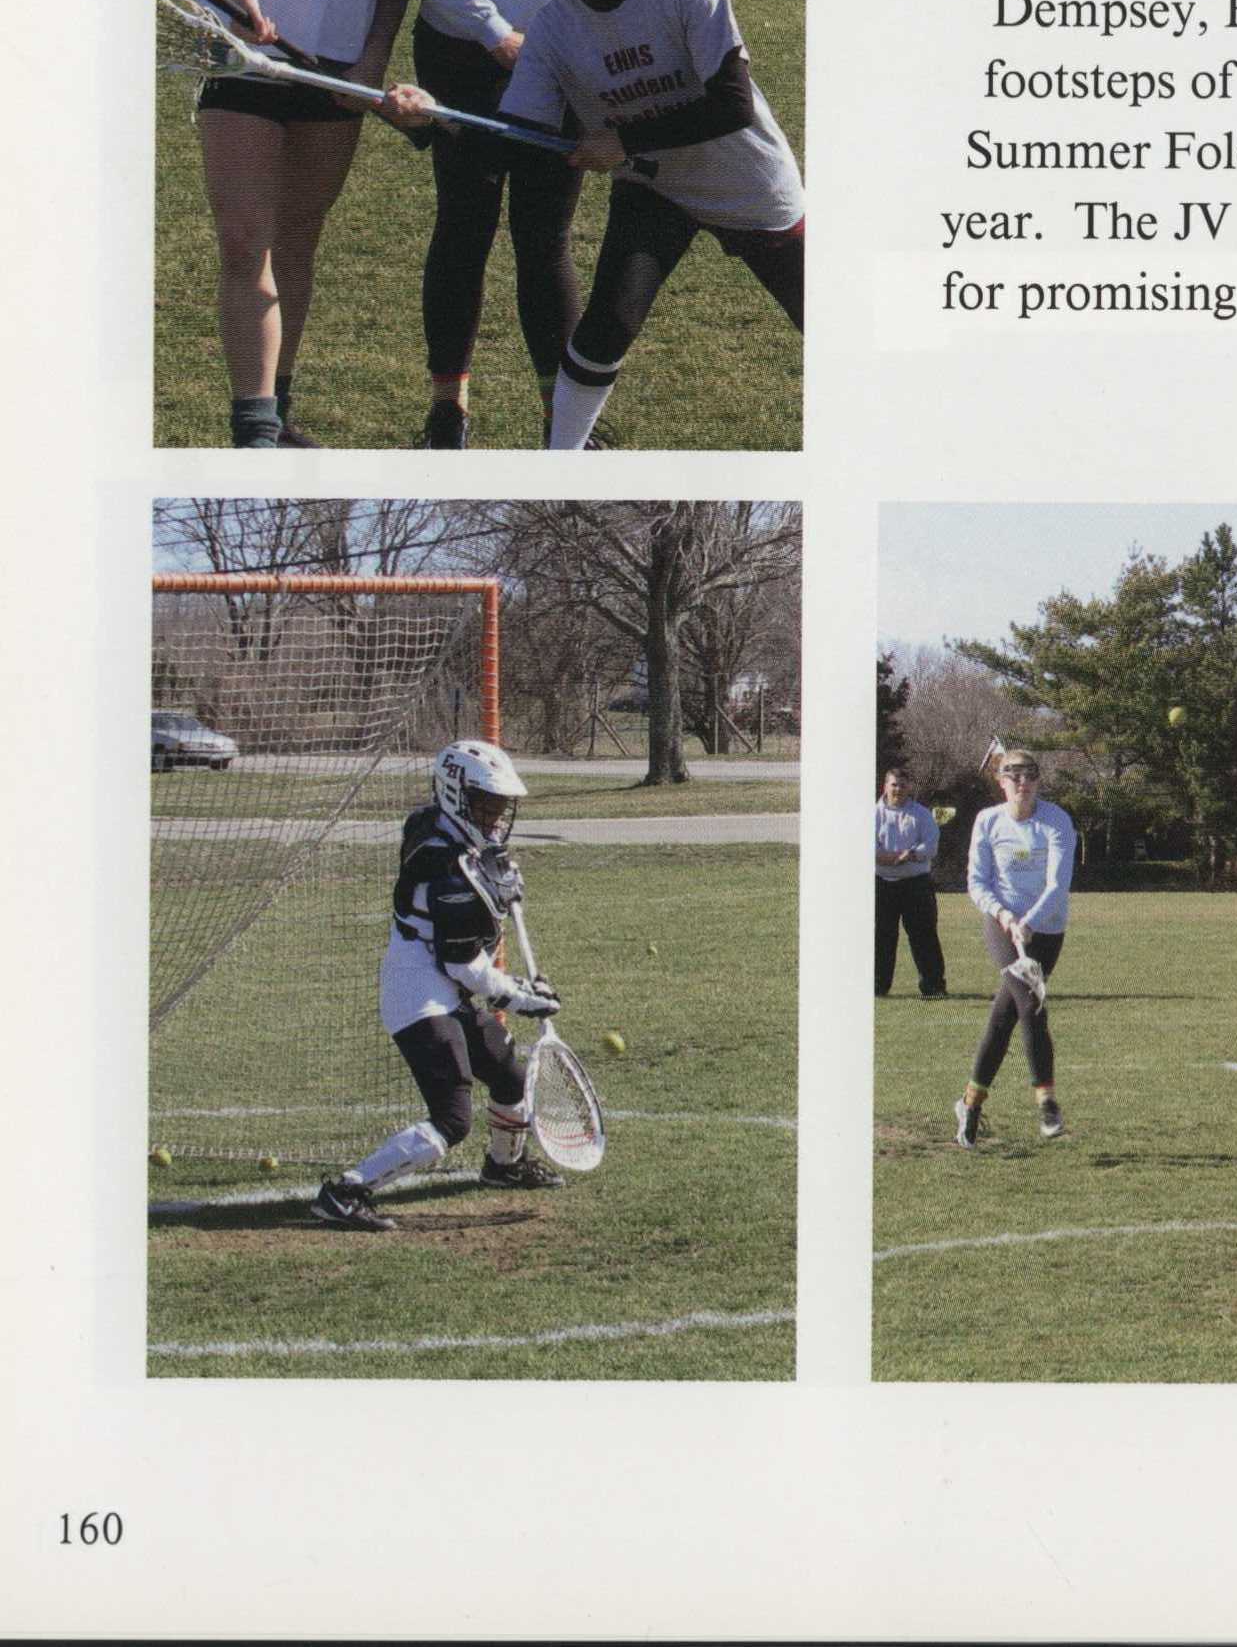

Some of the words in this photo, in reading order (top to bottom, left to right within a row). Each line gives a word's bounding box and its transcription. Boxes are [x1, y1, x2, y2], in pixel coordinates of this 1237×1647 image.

[984, 58, 1176, 108] footsteps
[967, 129, 1152, 170] Summer
[940, 212, 1043, 249] year.
[1074, 201, 1158, 241] The
[1173, 202, 1232, 241] JV
[942, 270, 1005, 311] for
[1018, 271, 1237, 321] promising
[60, 1512, 123, 1545] 160
